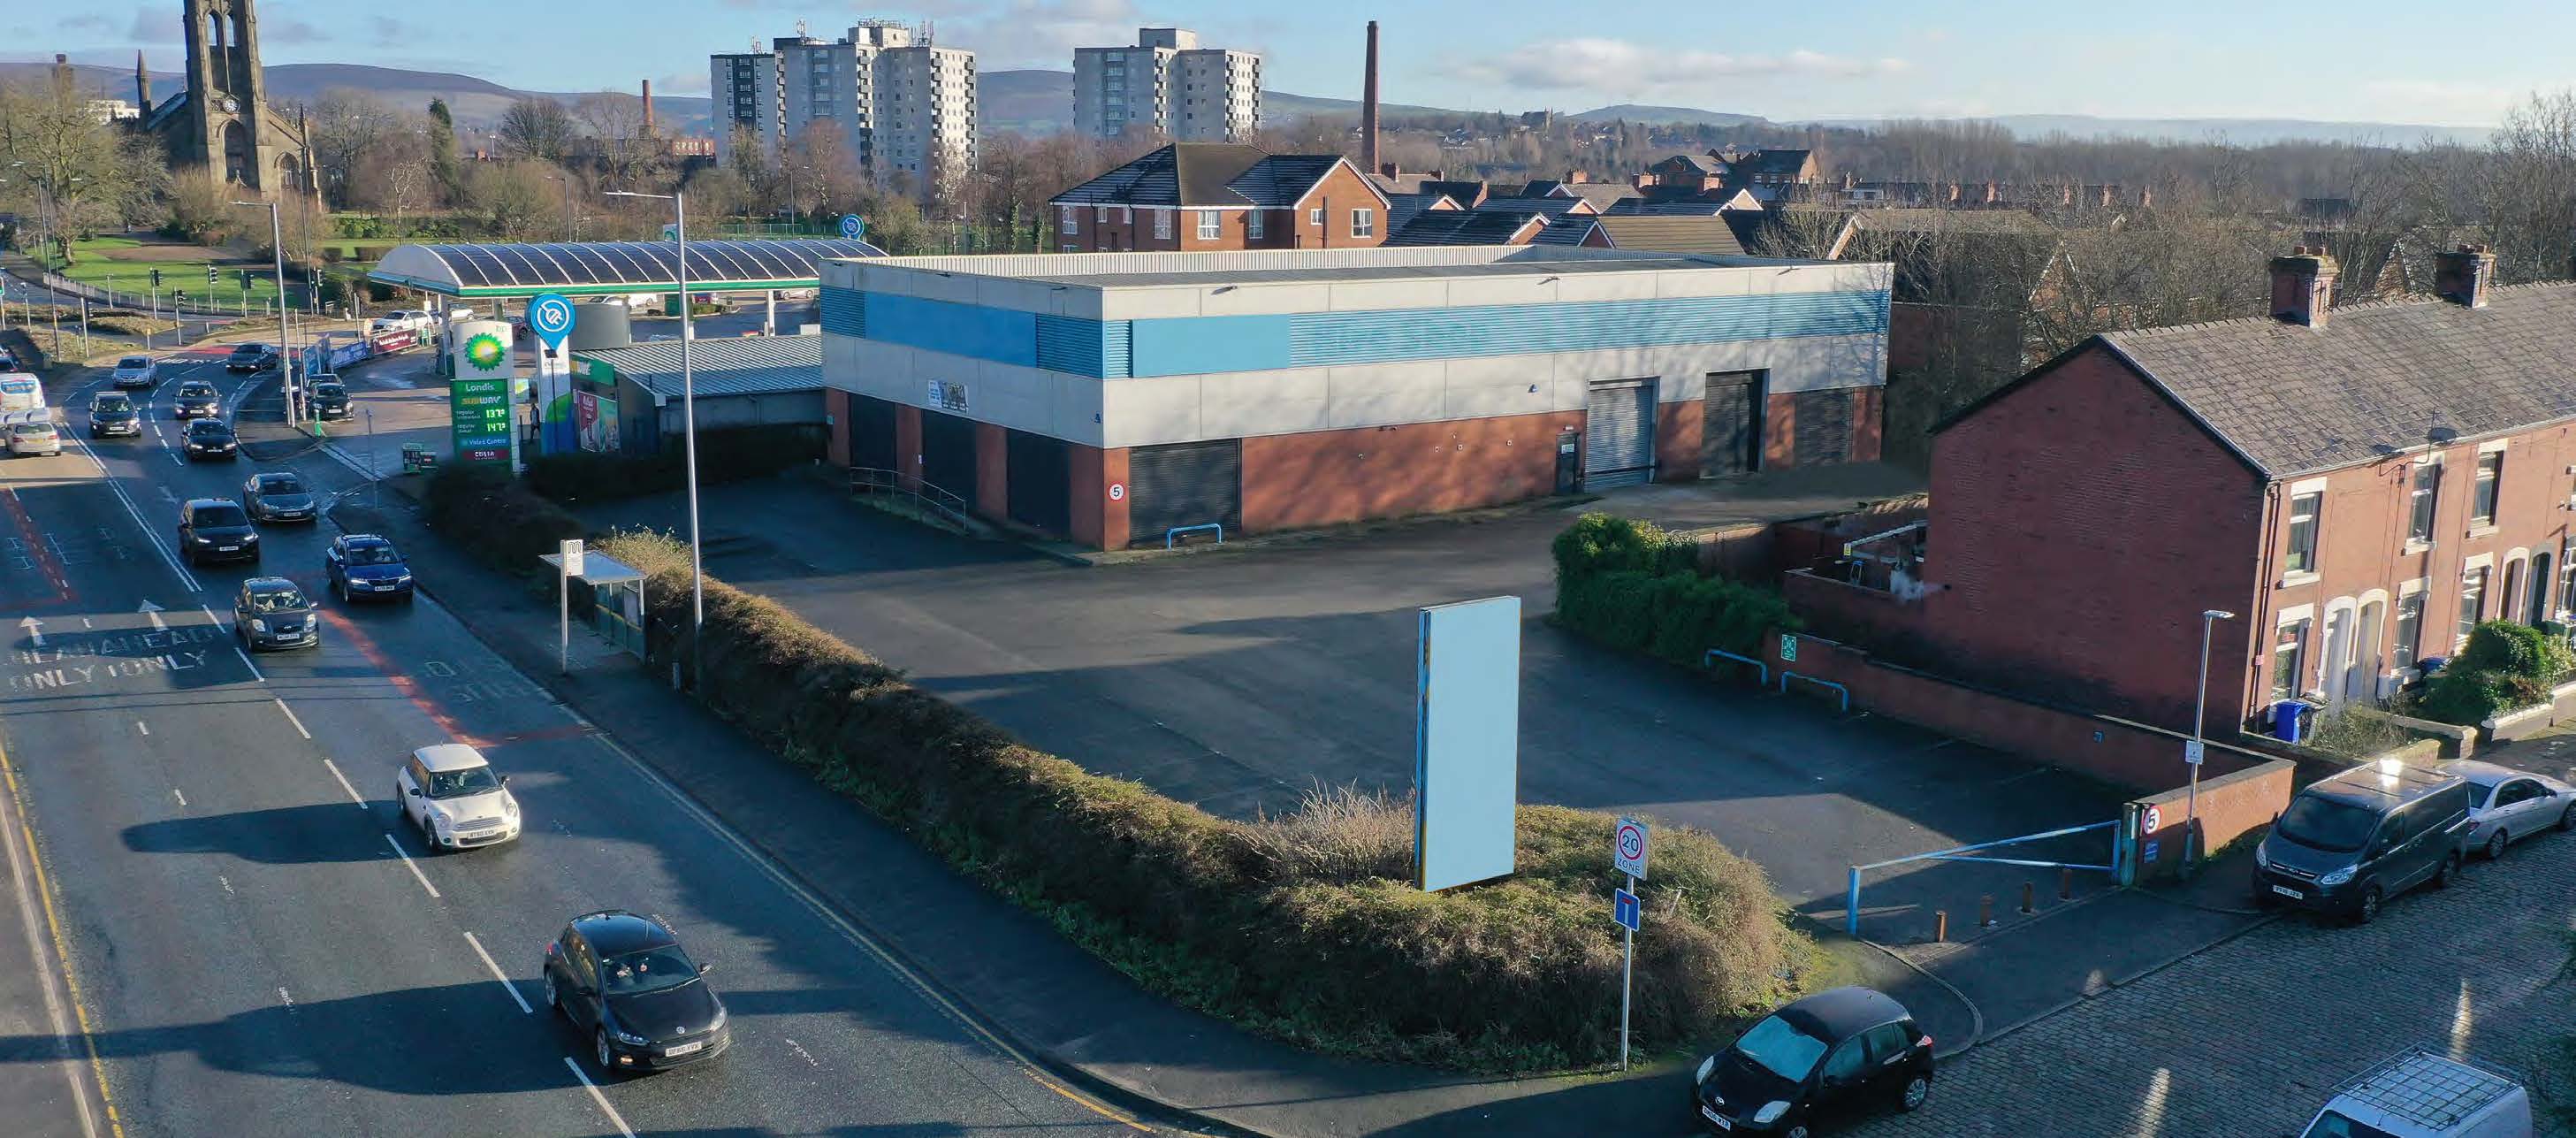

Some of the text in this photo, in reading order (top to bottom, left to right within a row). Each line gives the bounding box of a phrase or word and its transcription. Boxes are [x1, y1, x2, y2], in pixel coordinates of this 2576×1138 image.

[465, 382, 495, 392] Londis
[461, 395, 501, 405] SUBWAY
[1113, 486, 1120, 497] 5
[2148, 813, 2156, 829] 5
[1622, 834, 1639, 852] 20
[1617, 857, 1641, 875] ZONE
